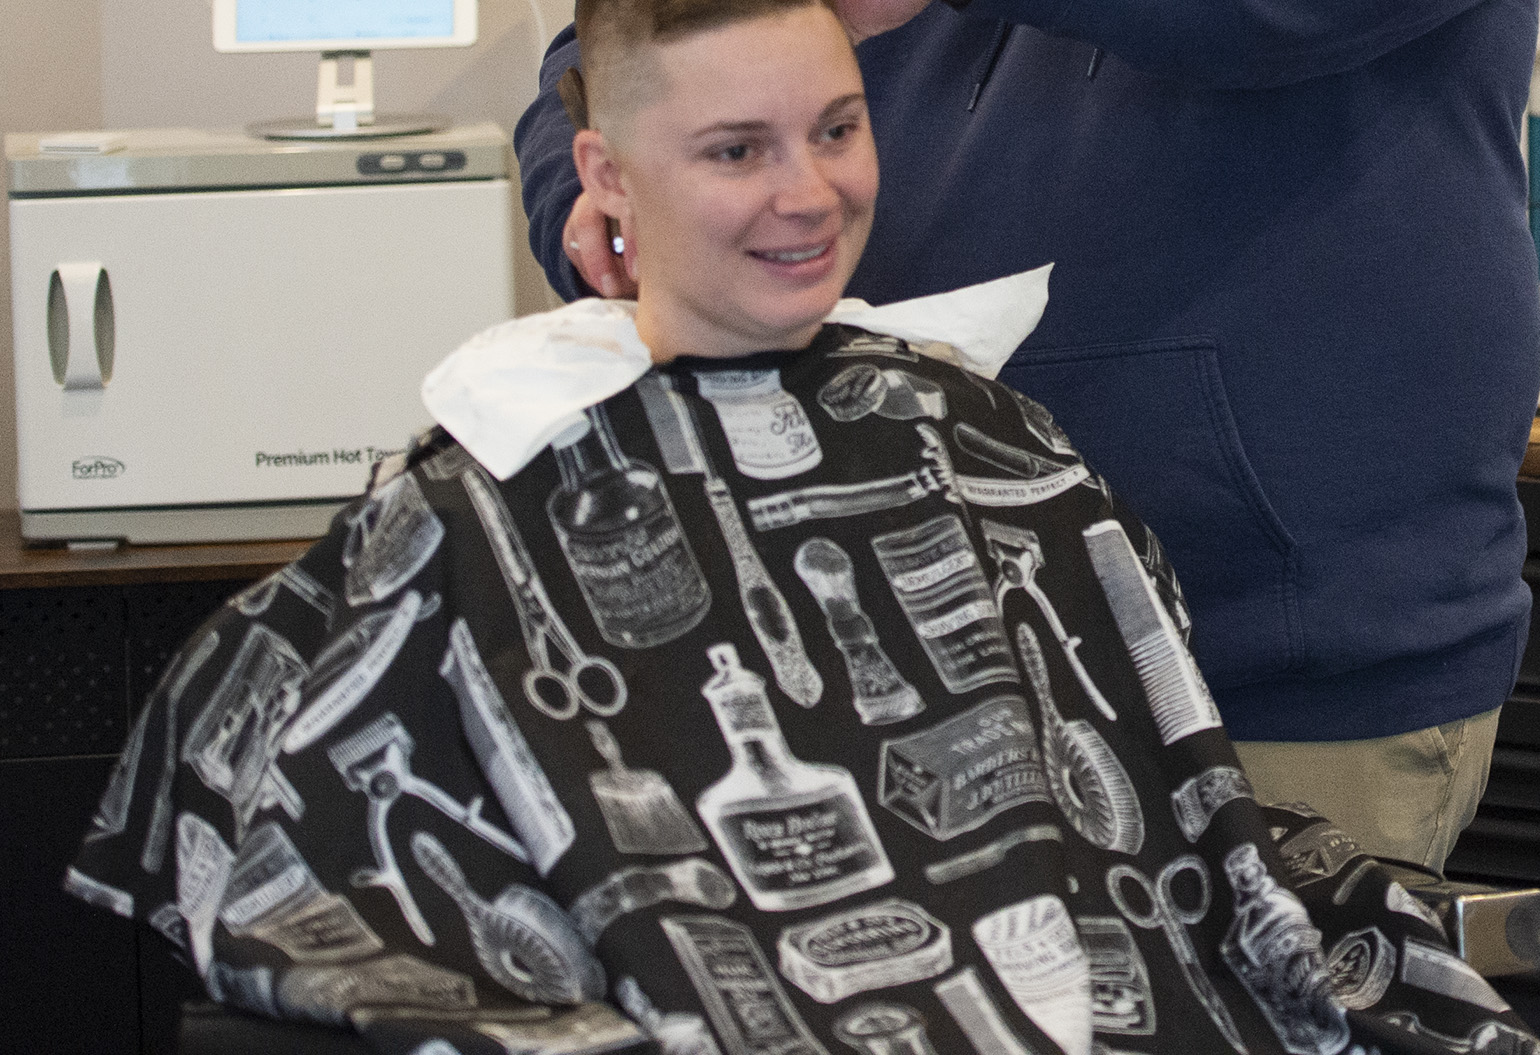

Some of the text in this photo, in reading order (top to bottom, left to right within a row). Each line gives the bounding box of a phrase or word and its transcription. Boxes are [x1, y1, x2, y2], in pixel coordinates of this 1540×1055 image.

[255, 444, 408, 468] Premium Hot Tow
